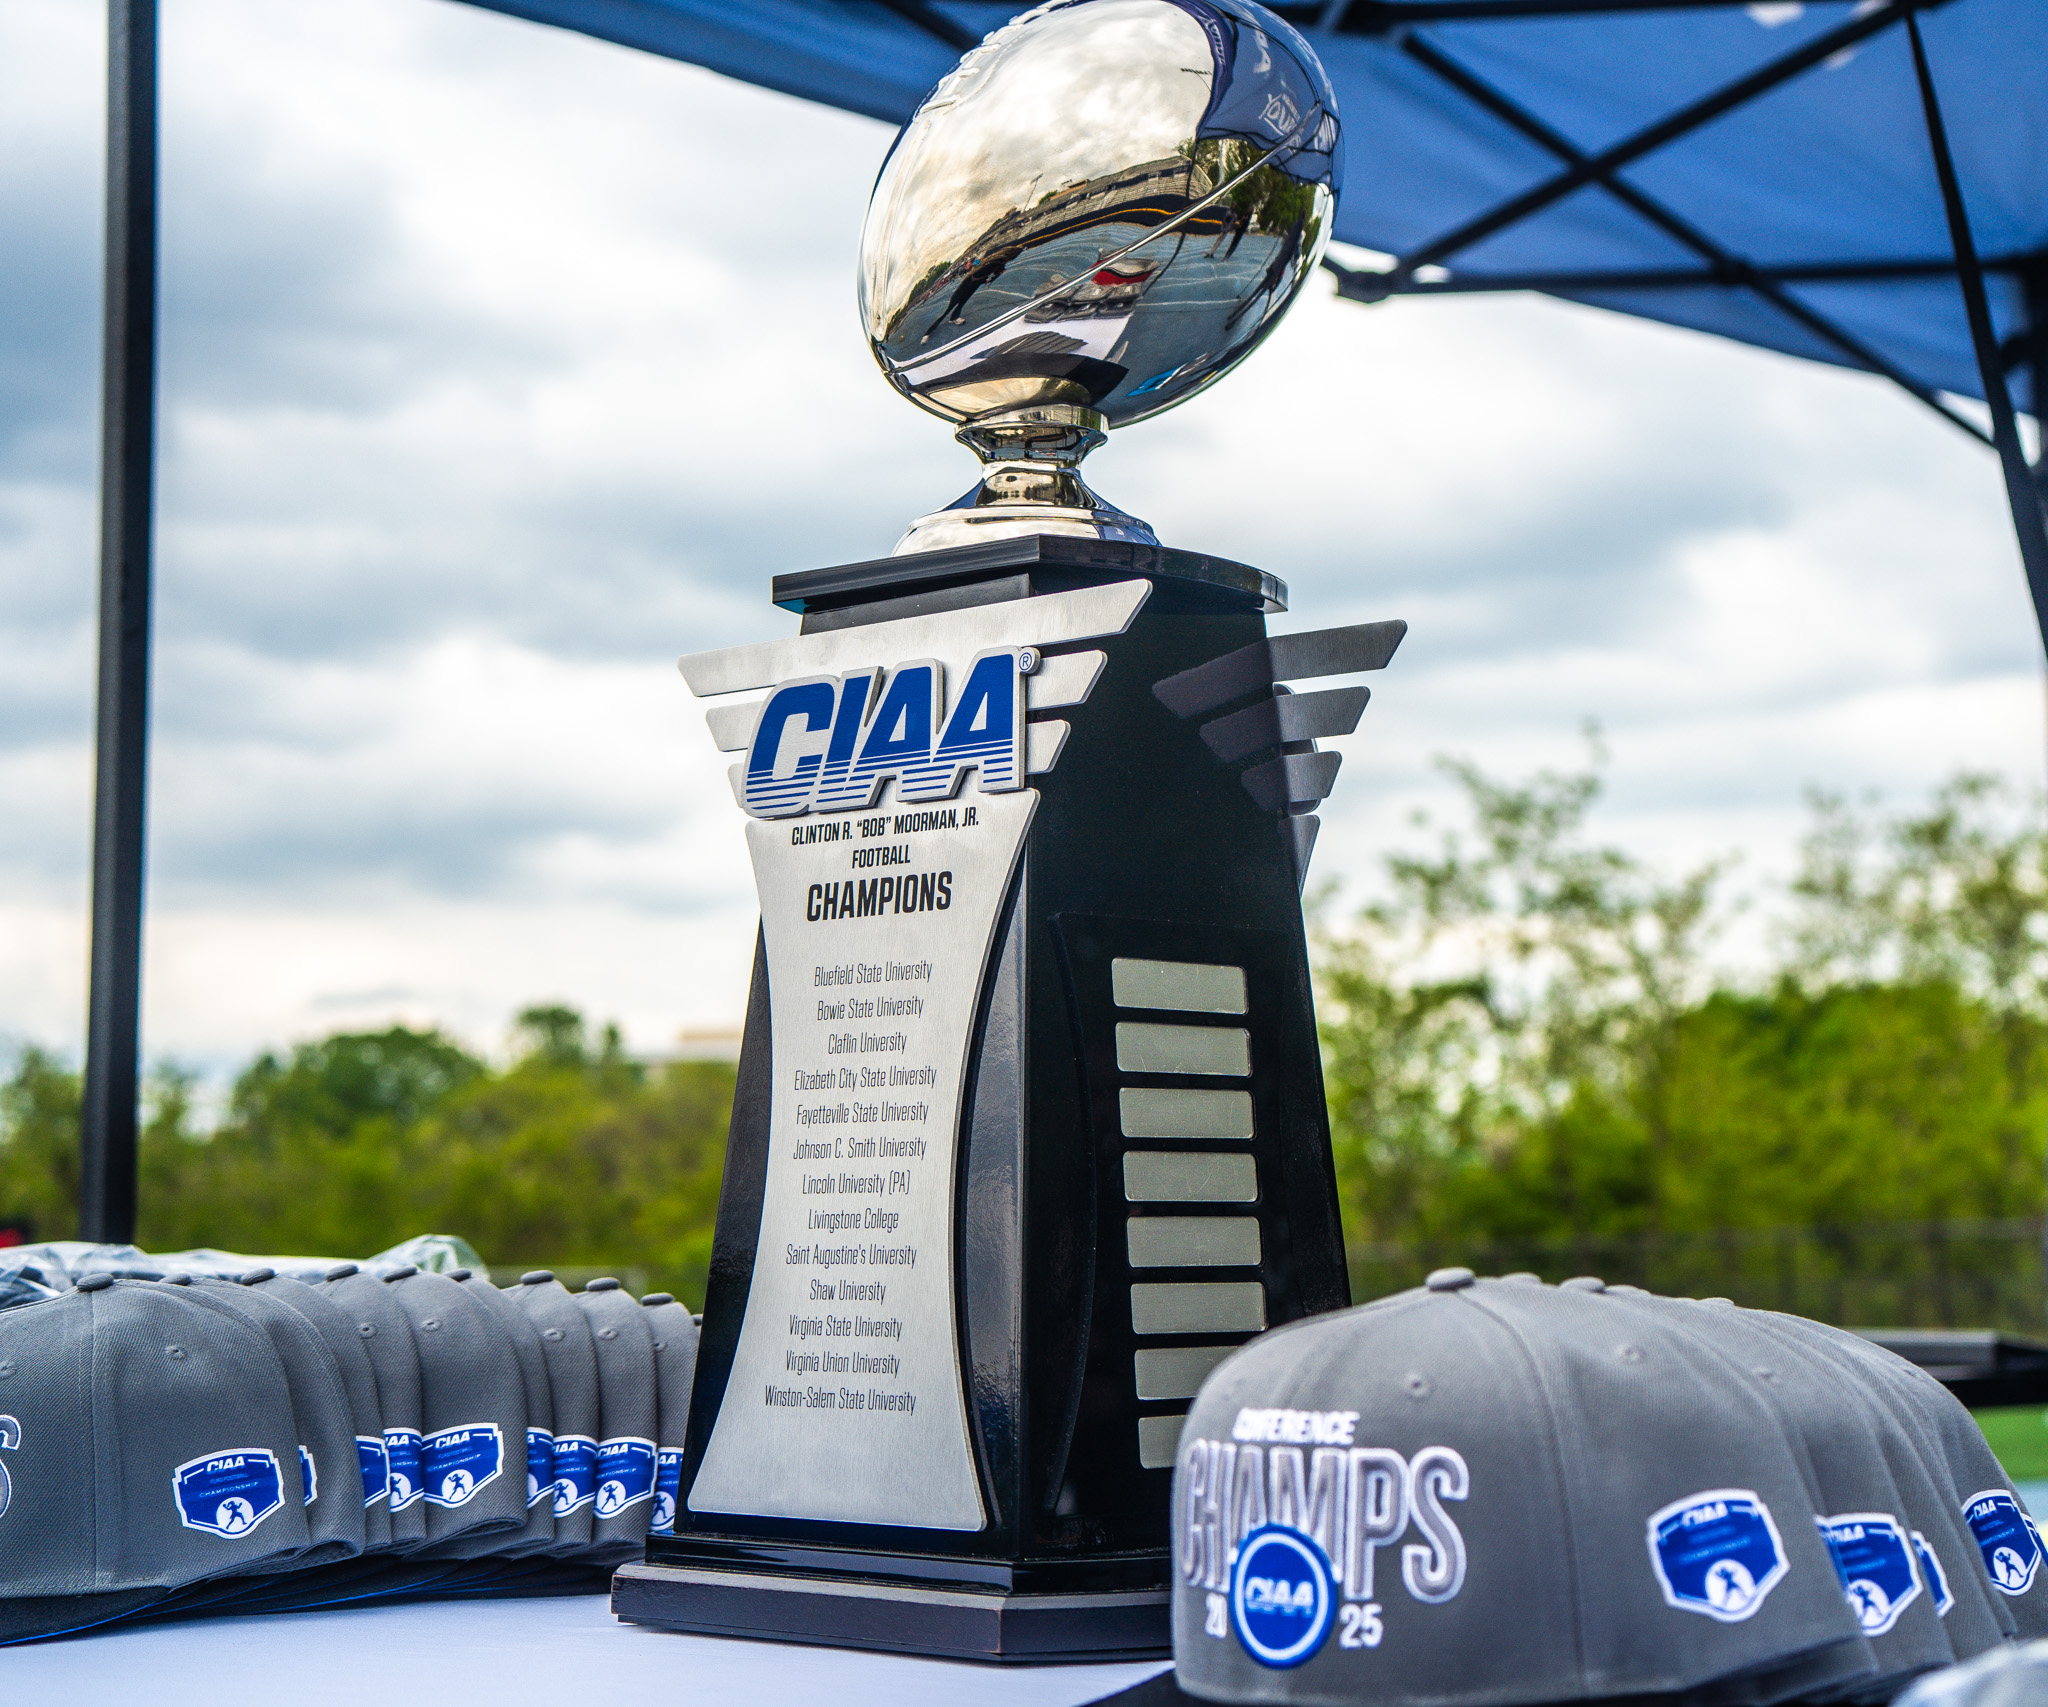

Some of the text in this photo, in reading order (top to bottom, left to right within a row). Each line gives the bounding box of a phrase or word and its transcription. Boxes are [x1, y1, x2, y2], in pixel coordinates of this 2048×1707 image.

[745, 652, 1015, 812] CIAA
[791, 823, 840, 846] CLINTON
[842, 822, 853, 840] R.
[893, 809, 961, 835] MOORMAN,
[962, 806, 979, 827] JR.
[851, 844, 911, 869] FOOTBALL
[806, 871, 953, 922] CHAMPIONS
[814, 960, 933, 987] Bluefield State University
[817, 995, 924, 1021] Bowie State University
[828, 1031, 907, 1055] Claflin University
[794, 1065, 937, 1092] Elizabeth City State University
[796, 1100, 929, 1128] Fayetteville State University
[793, 1136, 927, 1160] Johnson C. Smith University
[802, 1169, 911, 1197] Lincoln University (PA)
[808, 1207, 899, 1234] Livingstone College
[786, 1243, 917, 1270] Saint Augustine's University
[809, 1279, 887, 1305] Shaw University
[789, 1314, 903, 1342] Virginia State University
[786, 1350, 900, 1378] Virginia Union University
[765, 1384, 917, 1416] Winston-Salem State University
[435, 1431, 471, 1449] CIAA
[597, 1443, 629, 1458] CIAA
[207, 1455, 246, 1474] CIAA
[1338, 1603, 1384, 1649] 25
